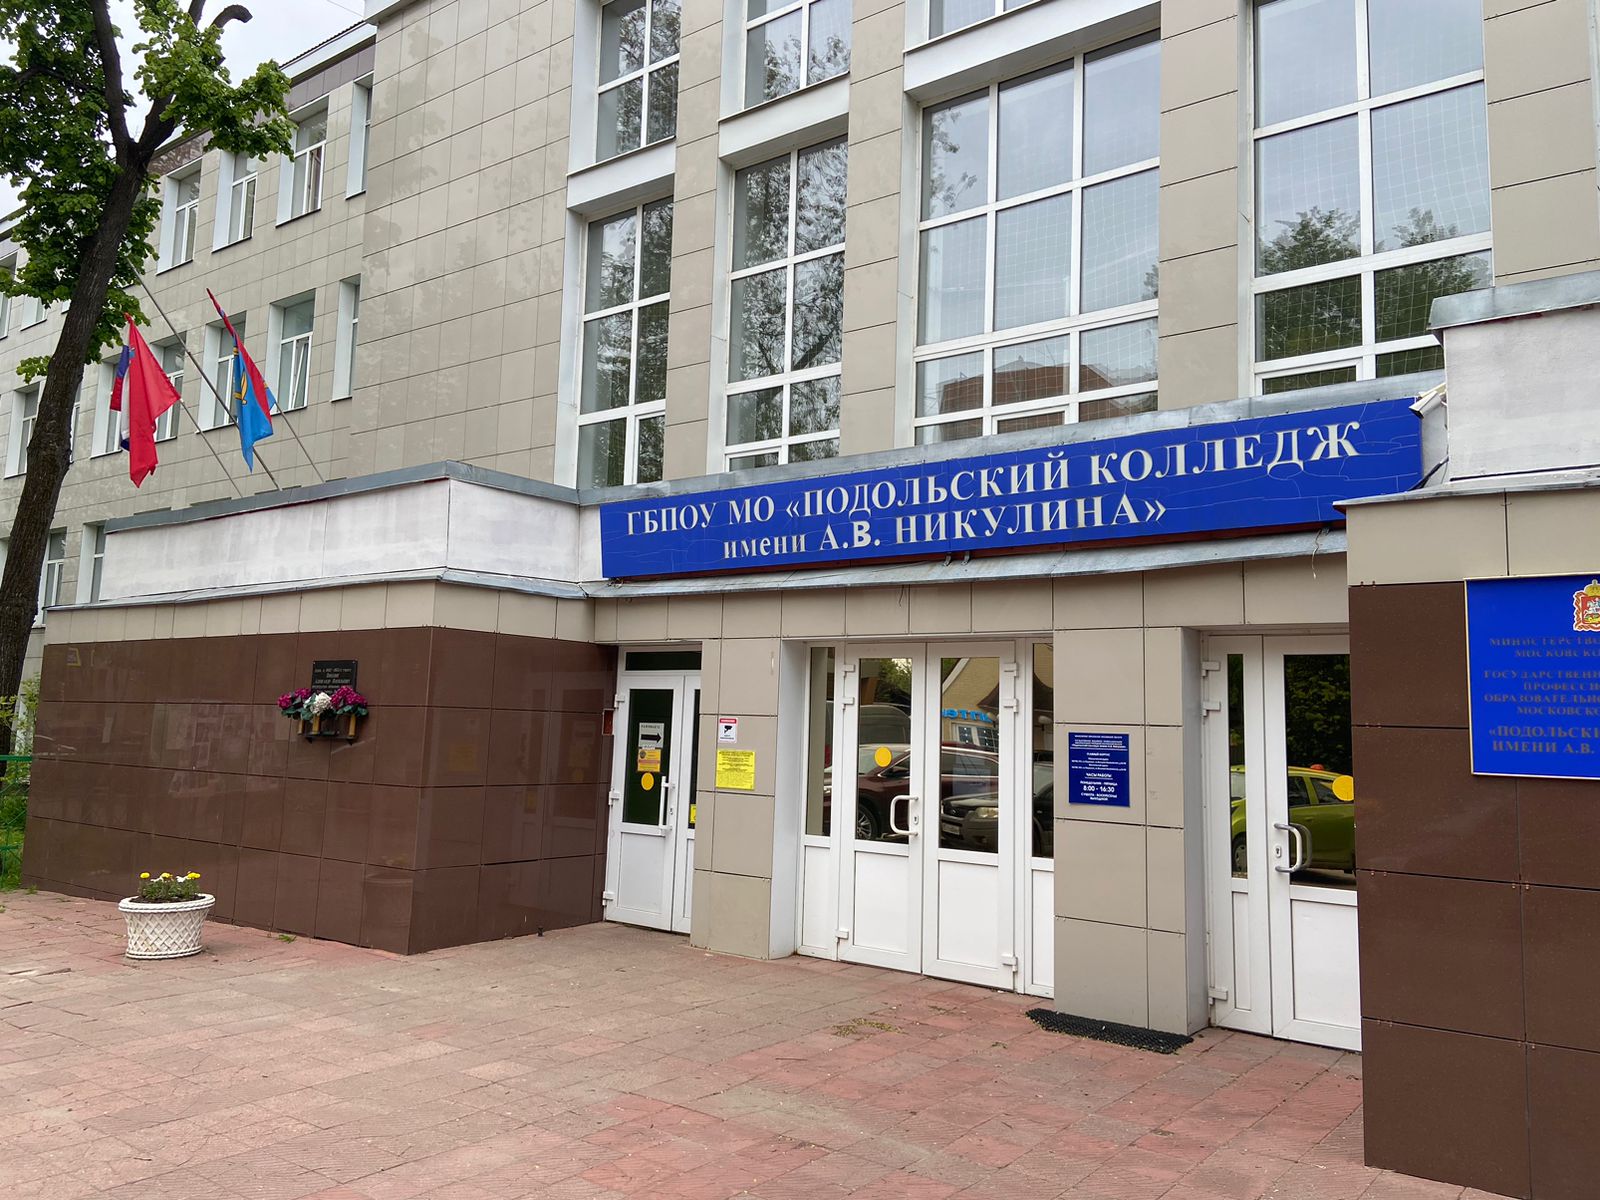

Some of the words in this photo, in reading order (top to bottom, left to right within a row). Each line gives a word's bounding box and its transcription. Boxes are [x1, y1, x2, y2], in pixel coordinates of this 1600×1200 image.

[626, 502, 717, 536] ГБПОУ
[728, 495, 775, 525] МО
[785, 450, 1069, 521] «ПОДОЛЬСКИЙ
[1090, 421, 1361, 486] КОЛЛЕДЖ
[723, 534, 806, 560] имени
[819, 520, 881, 552] А.В.
[894, 493, 1167, 545] НИКУЛИНА»
[1493, 741, 1557, 753] ИМЕНИ
[1563, 743, 1595, 754] А.В.
